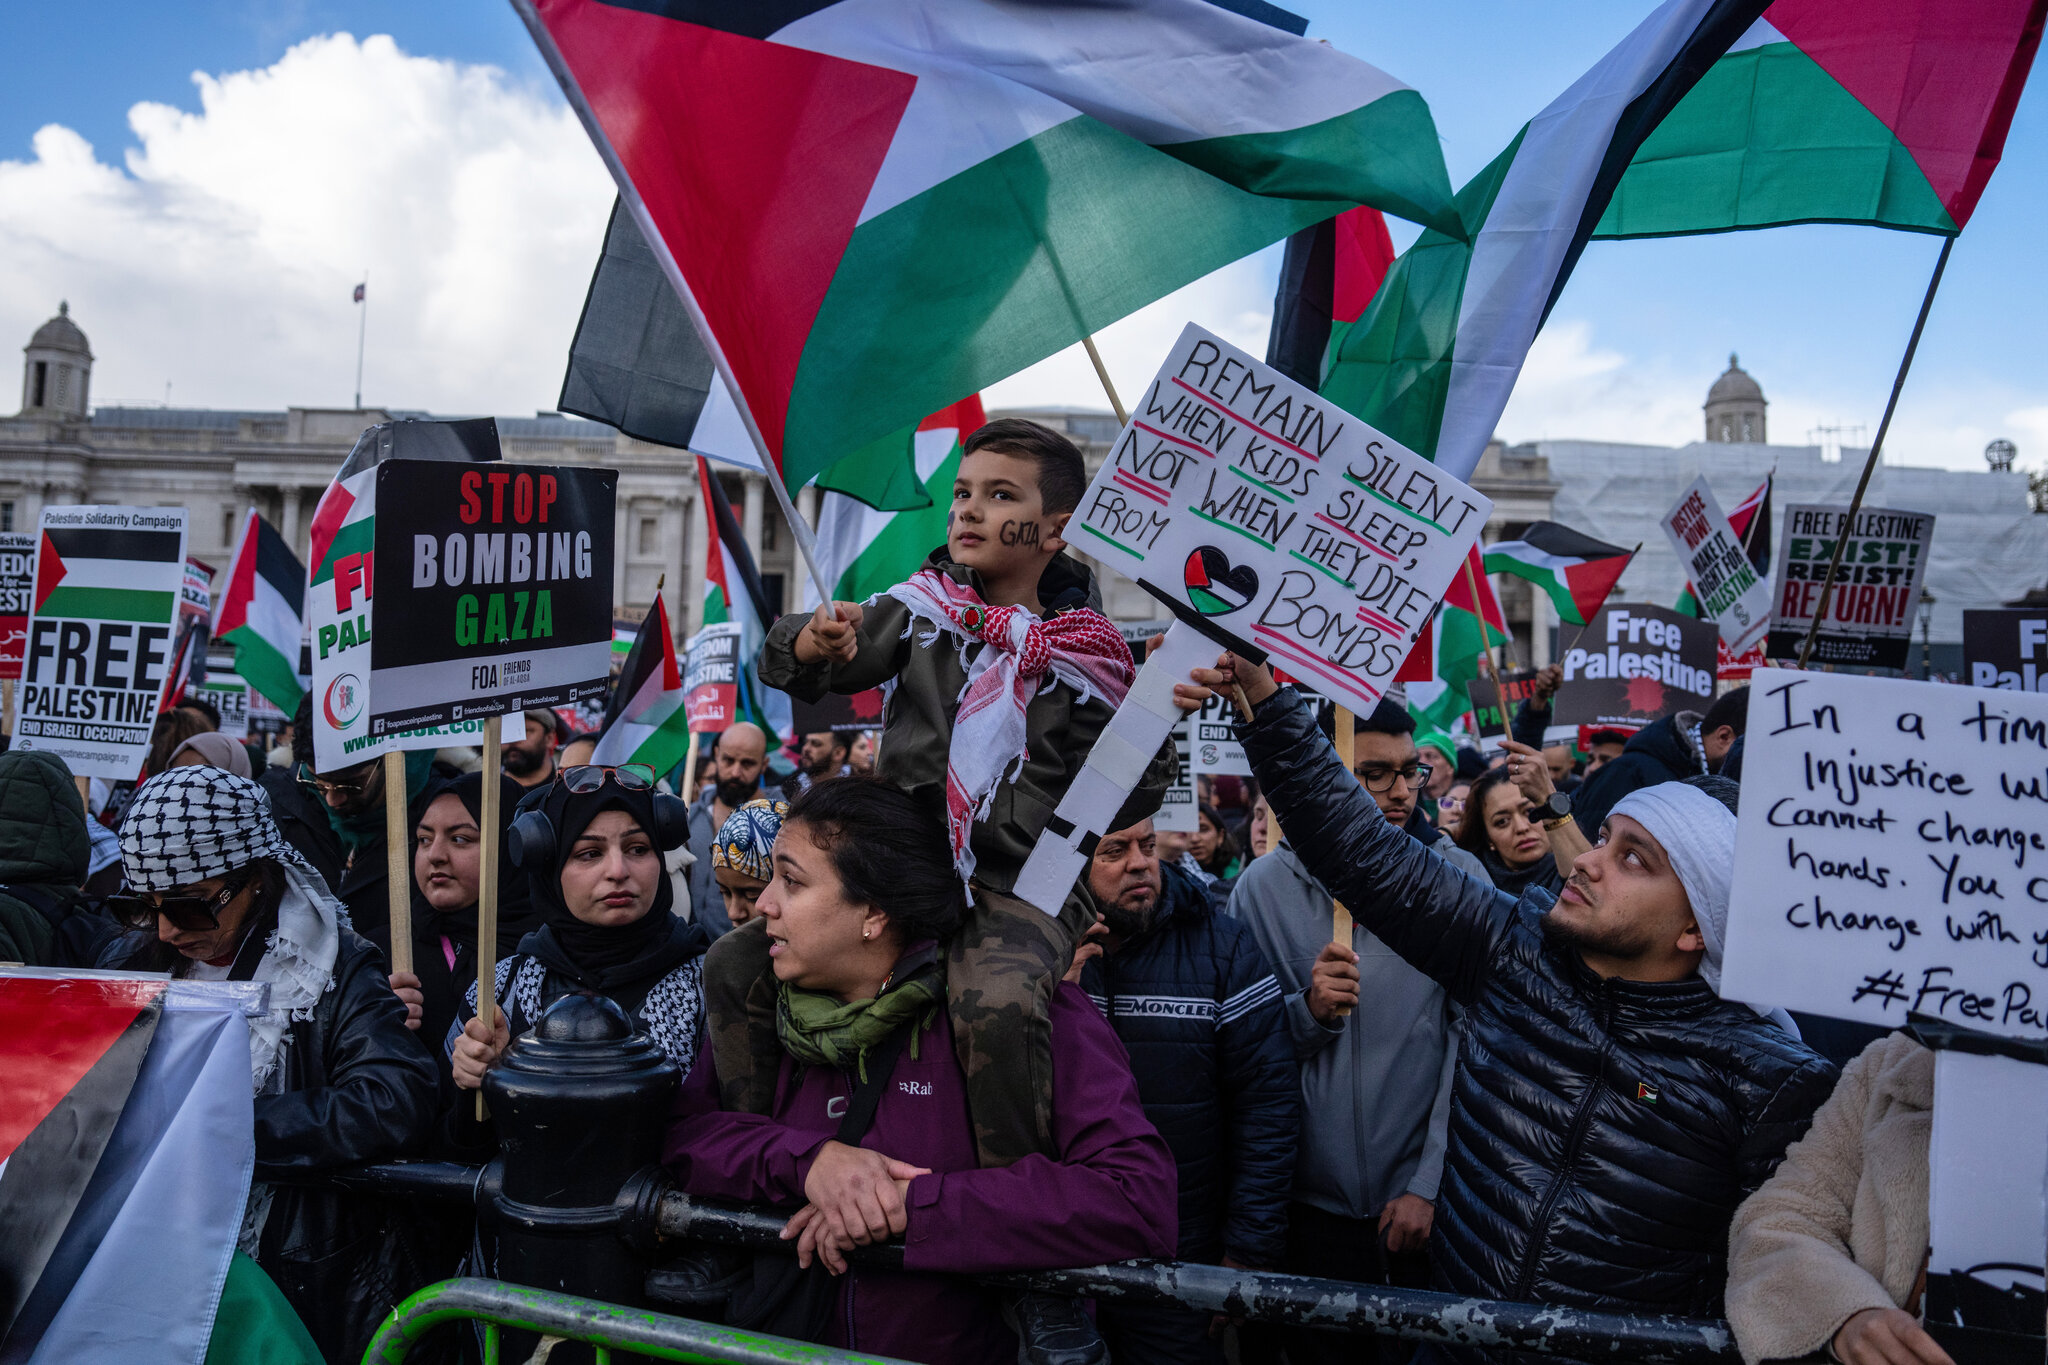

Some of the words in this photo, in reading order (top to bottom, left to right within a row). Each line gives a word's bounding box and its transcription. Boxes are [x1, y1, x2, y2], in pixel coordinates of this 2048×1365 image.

[1178, 340, 1344, 457] REMAIN
[1346, 441, 1479, 534] SILENT
[459, 470, 557, 525] STOP
[1146, 381, 1236, 453] WHEN
[1240, 439, 1320, 496] KIDS
[1325, 490, 1428, 571] SLEEP,
[44, 512, 83, 525] Palestine
[84, 512, 130, 527] Solidarity
[132, 513, 182, 529] Campaign
[1000, 519, 1040, 551] GAZA
[1115, 429, 1198, 489] NOT
[1200, 468, 1297, 545] WHEN
[1300, 524, 1370, 588] THEY
[1354, 563, 1441, 643] DIE!
[1670, 489, 1707, 539] JUSTICE
[1682, 514, 1712, 551] NOW!
[1792, 511, 1833, 536] FREE
[413, 530, 593, 588] BOMBING
[1691, 540, 1721, 577] MAKE
[1715, 530, 1730, 554] IT
[1696, 562, 1727, 600] RIGHT
[1723, 545, 1745, 574] FOR
[1786, 562, 1916, 587] RESIST!
[1788, 538, 1921, 566] EXIST!
[1087, 486, 1170, 550] FROM
[1258, 571, 1402, 678] BOMBS
[1705, 563, 1758, 622] PALESTINE
[1781, 580, 1911, 626] RETURN!
[455, 589, 553, 647] GAZA
[1606, 609, 1682, 651] Free
[2019, 618, 2048, 660] F
[26, 620, 171, 692] FREE
[471, 664, 498, 691] FOA
[503, 660, 531, 676] FRIENDS
[1562, 645, 1713, 698] Palestine
[22, 685, 157, 724] PALESTINE
[503, 677, 510, 686] OF
[21, 720, 41, 736] END
[42, 721, 81, 739] ISRAELI
[83, 725, 149, 744] OCCUPATION
[1201, 726, 1228, 740] END
[1765, 680, 1840, 736] In
[1897, 712, 1925, 740] a
[1962, 701, 2048, 749] tim
[1804, 748, 1975, 806] Injustice
[2000, 768, 2048, 803] w
[1767, 797, 1898, 833] Cannot
[1918, 811, 2046, 869] change
[1788, 837, 1907, 889] hands.
[1929, 854, 2005, 904] You
[1786, 896, 1922, 951] change
[1946, 910, 2021, 944] with
[1131, 999, 1215, 1017] MONCLER
[1852, 967, 2048, 1031] #FreePa
[908, 1081, 933, 1096] Rab
